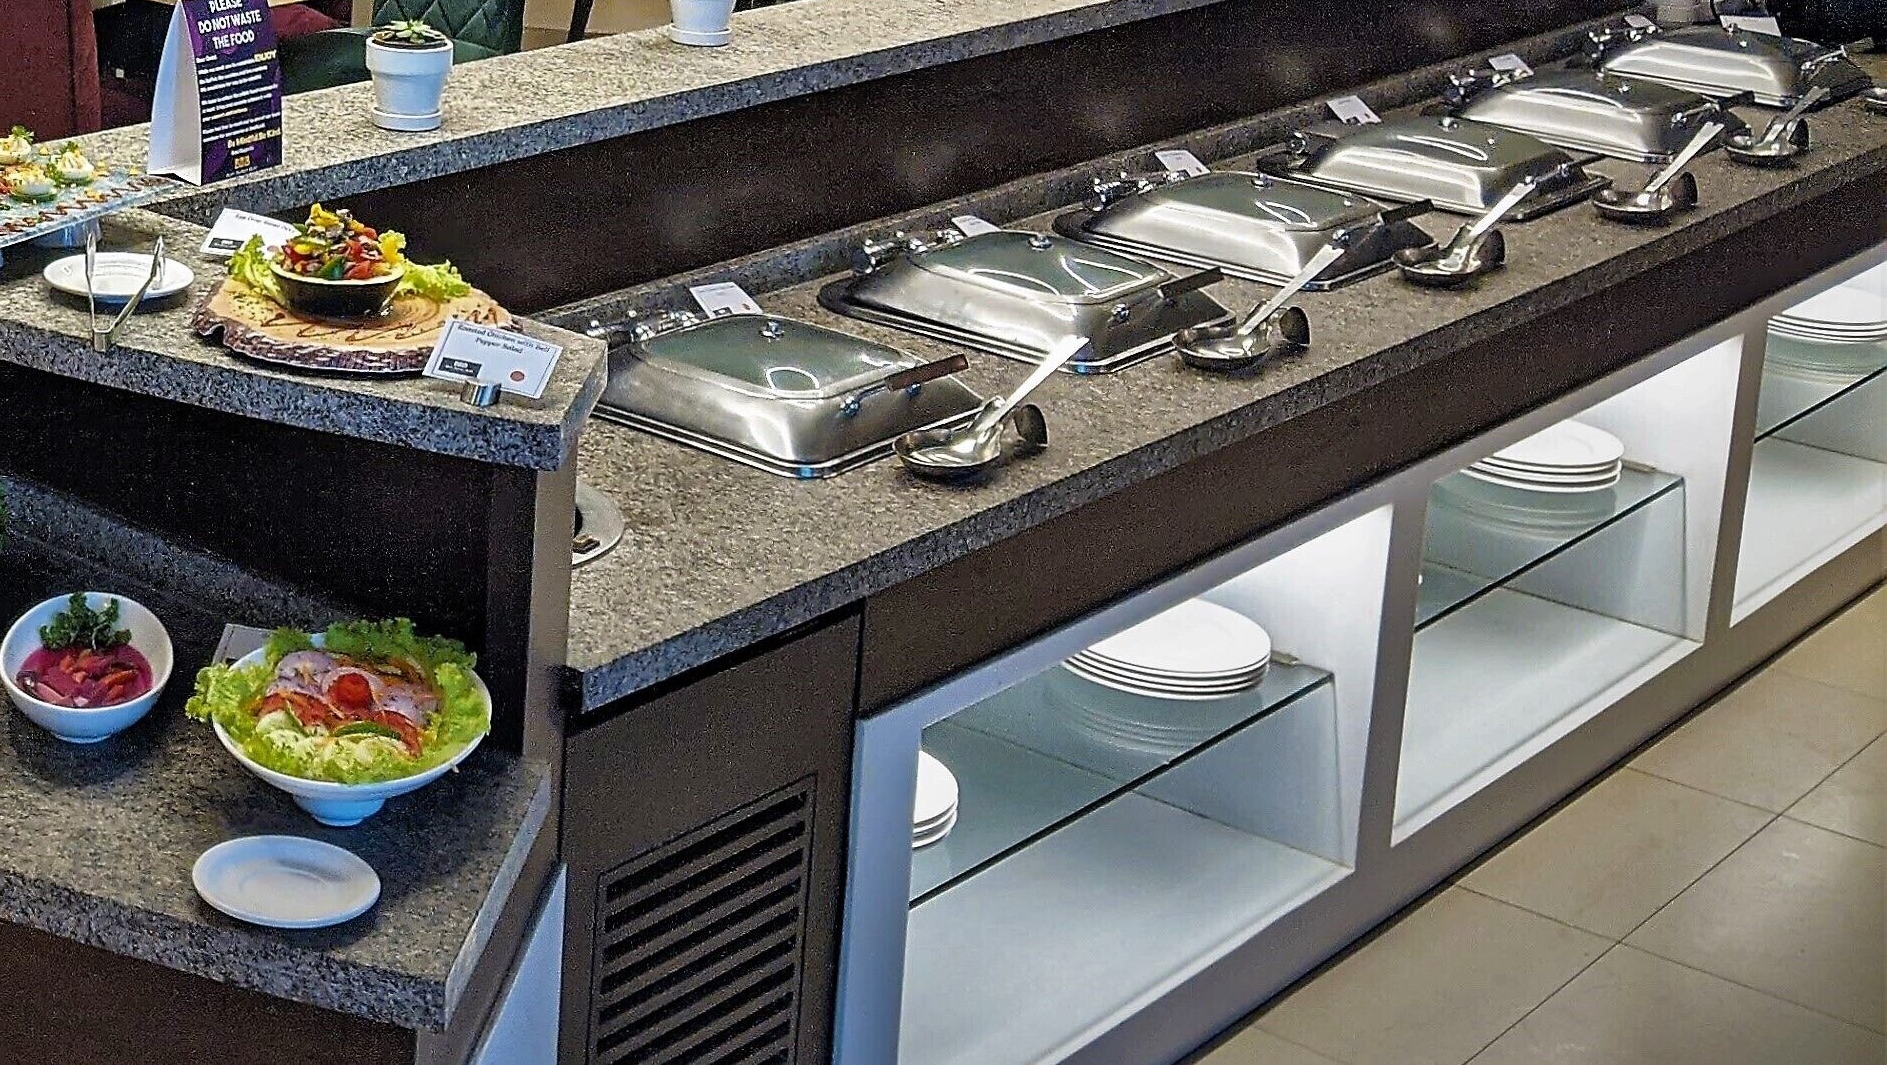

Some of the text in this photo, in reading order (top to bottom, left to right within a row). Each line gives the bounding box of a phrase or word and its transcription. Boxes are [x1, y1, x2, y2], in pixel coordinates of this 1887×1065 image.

[197, 9, 262, 34] DO NOT WASTE
[212, 29, 255, 49] THE FOOD
